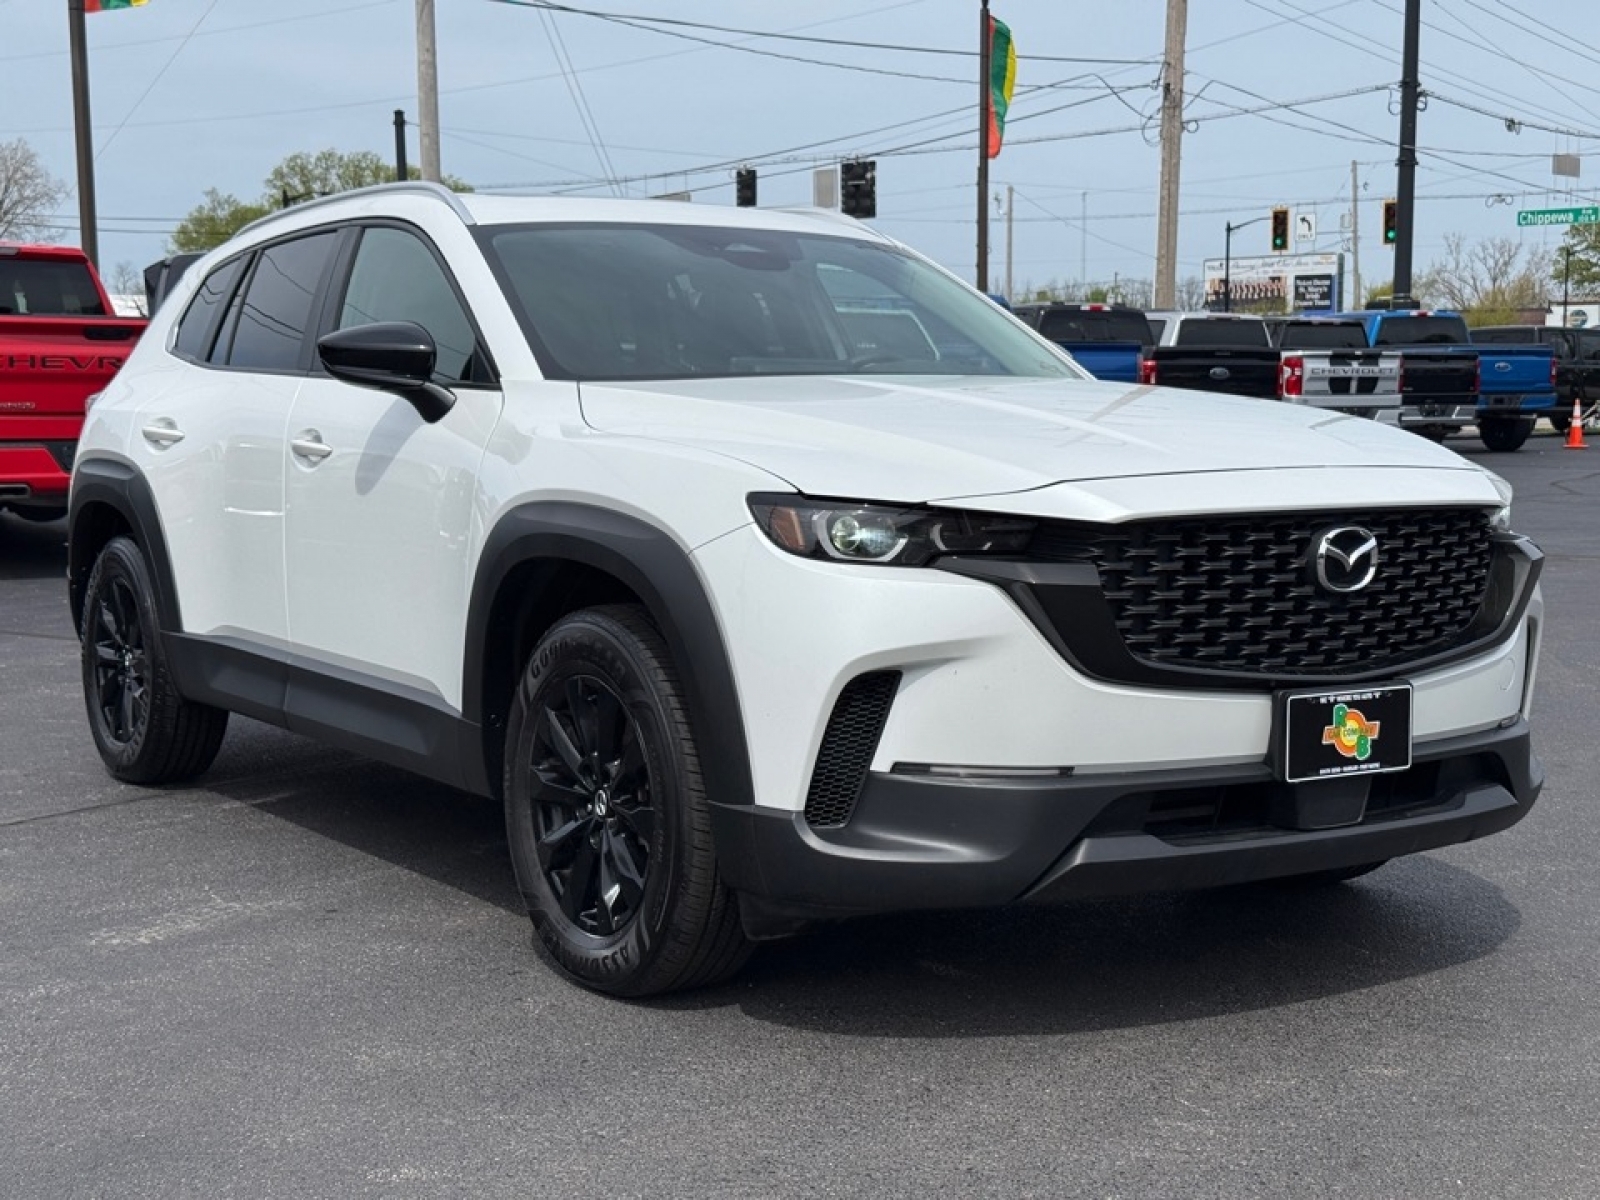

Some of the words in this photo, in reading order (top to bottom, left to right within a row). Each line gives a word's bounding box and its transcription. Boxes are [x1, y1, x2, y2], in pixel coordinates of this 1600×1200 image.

[1519, 211, 1573, 225] Chippewa
[0, 355, 122, 370] HEVR
[1310, 367, 1395, 376] CHEVROLET
